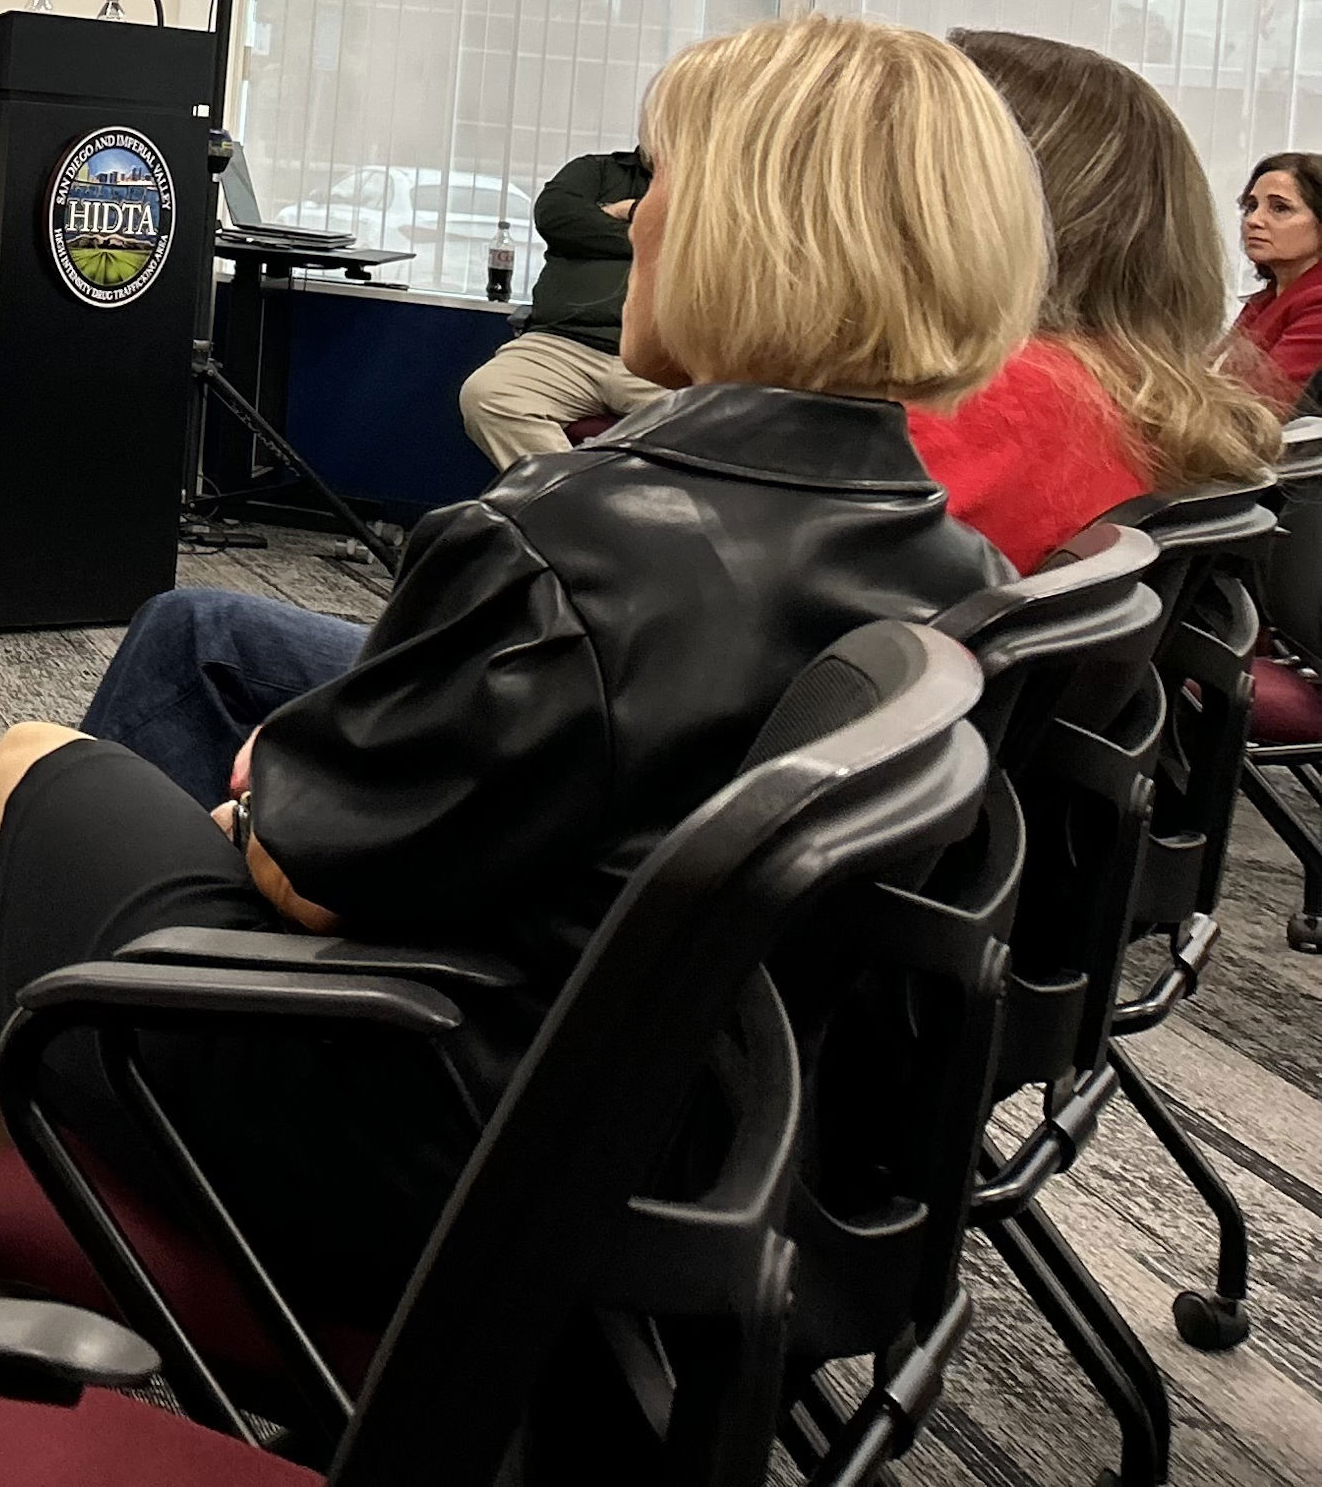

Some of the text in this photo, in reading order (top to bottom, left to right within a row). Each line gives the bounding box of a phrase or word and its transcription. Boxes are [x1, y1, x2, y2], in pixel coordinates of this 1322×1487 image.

[56, 134, 171, 210] SAN DIEGO AND IMPERIAL VALLEY
[65, 200, 157, 236] HIDTA
[54, 228, 66, 257] HIGH
[91, 289, 114, 300] DRUG
[114, 262, 158, 300] TRAFFICKING
